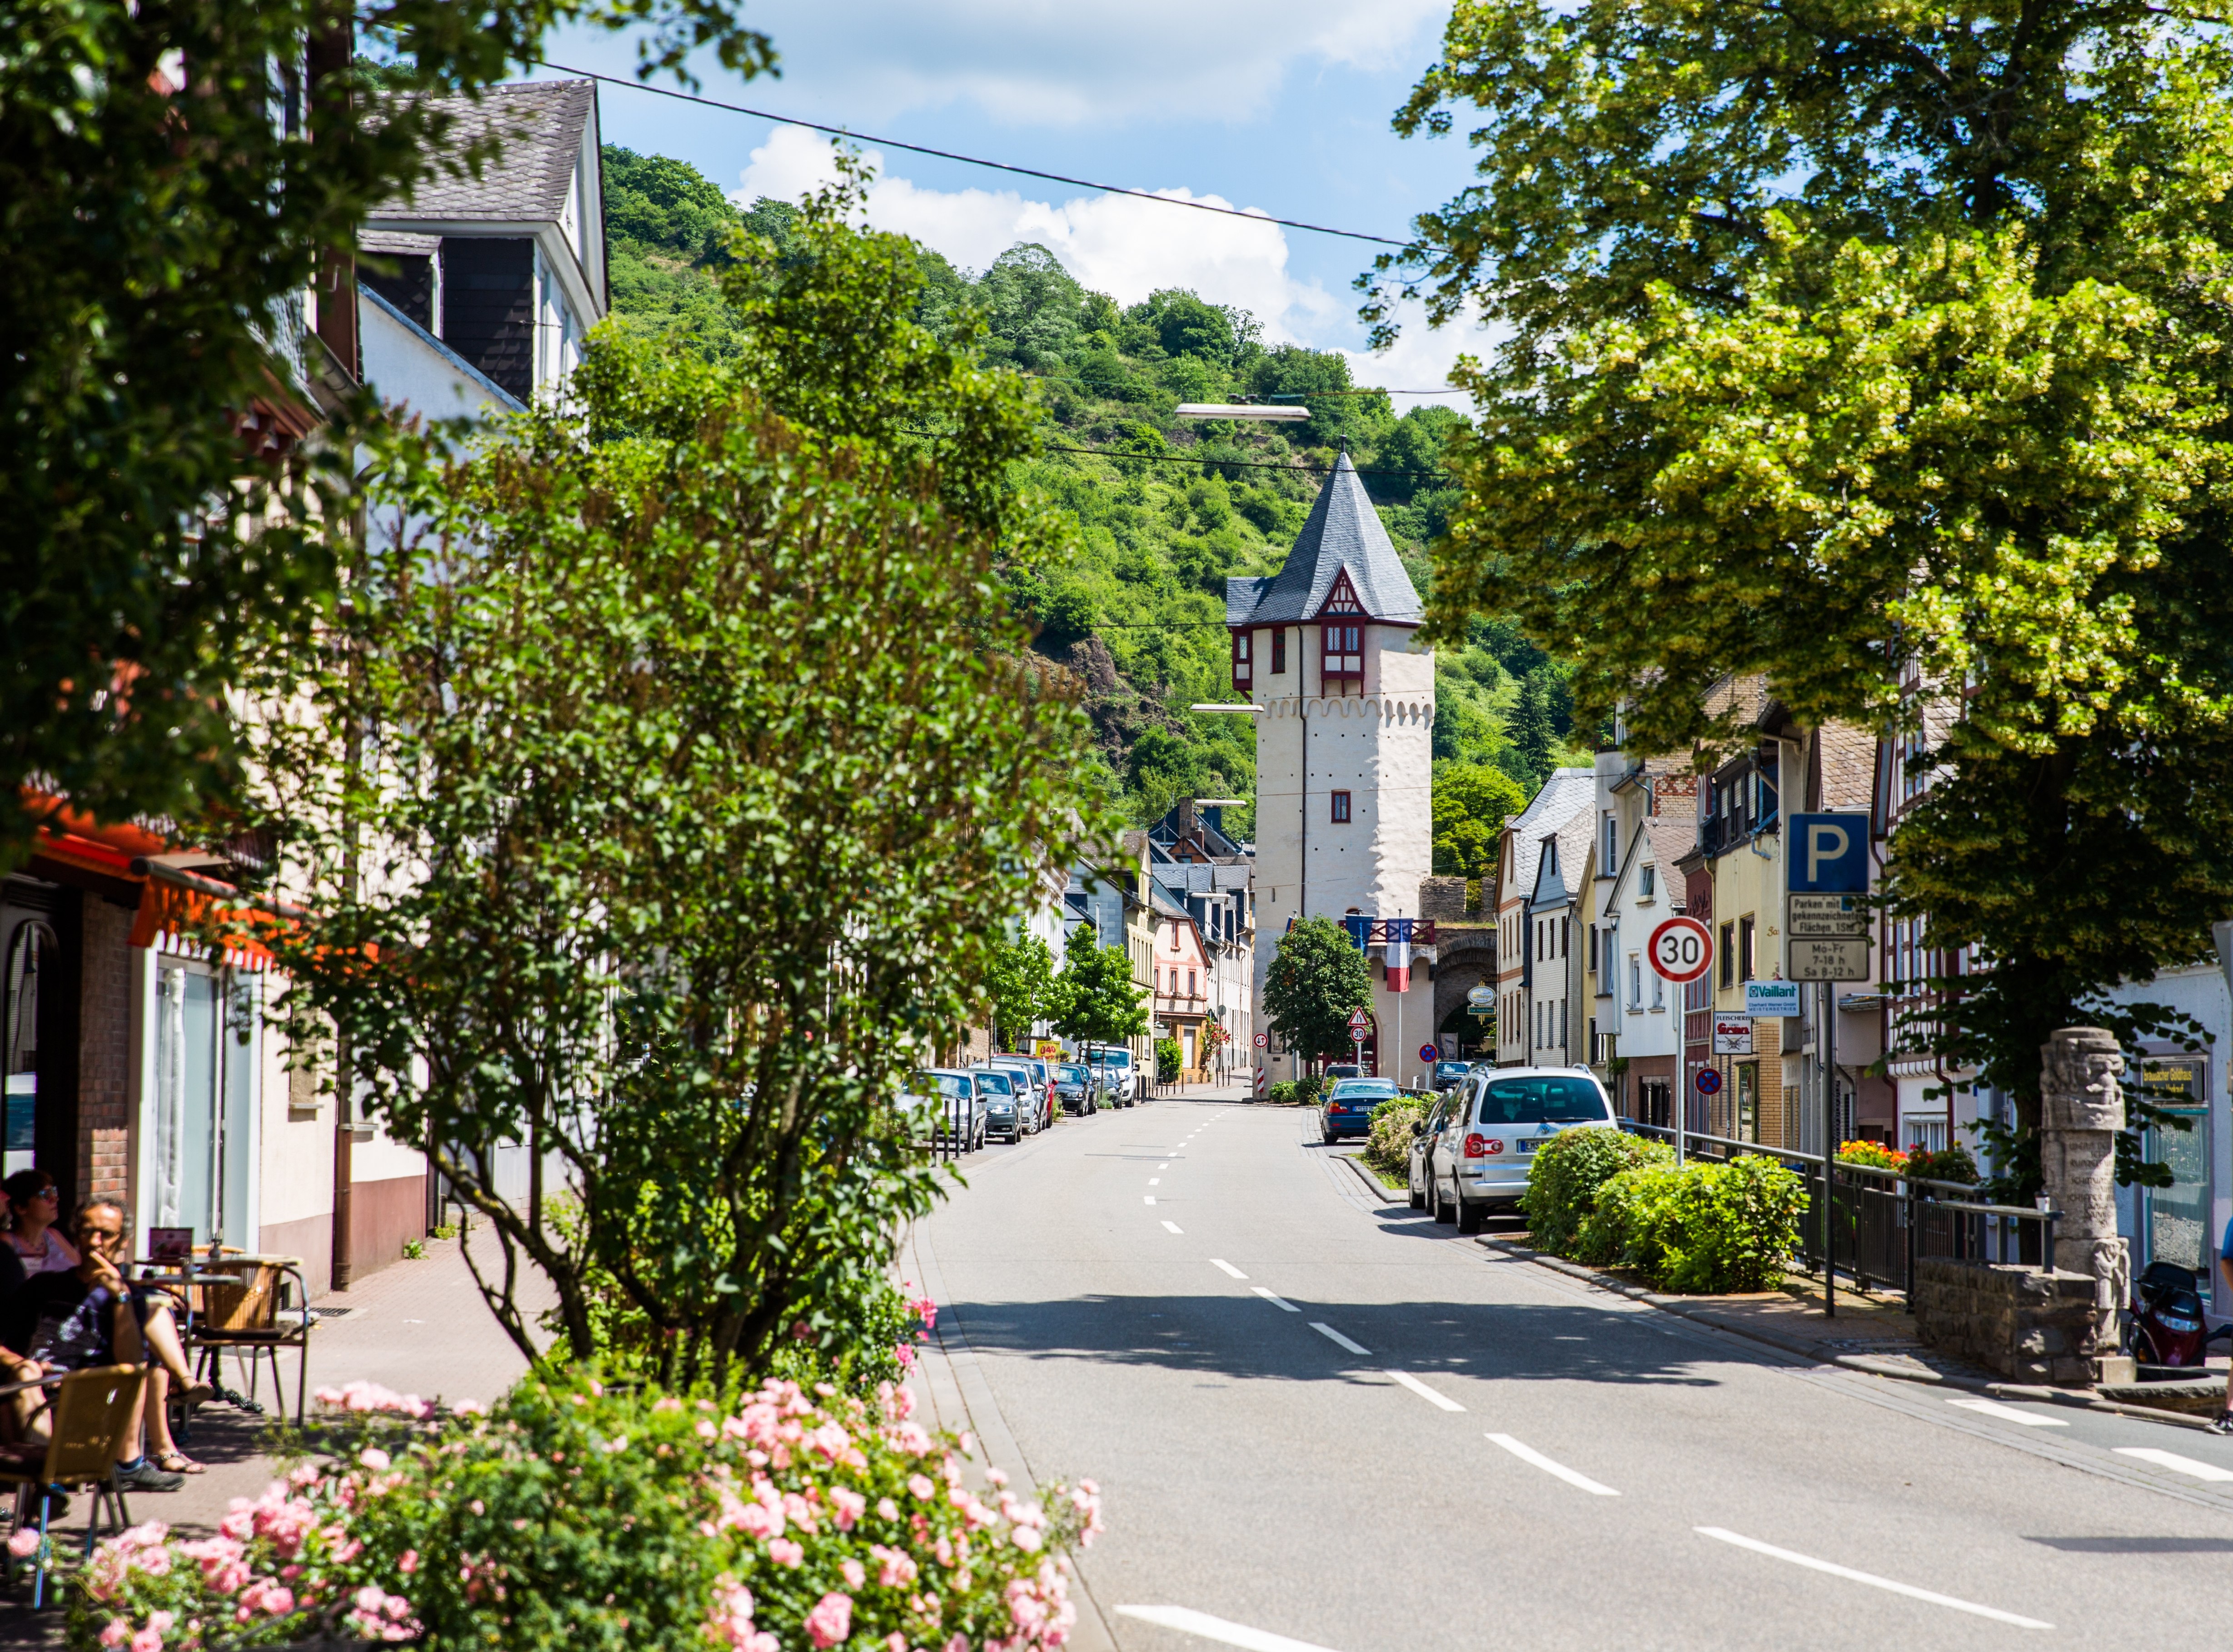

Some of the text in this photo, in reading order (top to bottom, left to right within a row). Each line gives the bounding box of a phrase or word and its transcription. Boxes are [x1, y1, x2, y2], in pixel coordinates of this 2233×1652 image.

[1808, 824, 1849, 882] P
[1794, 899, 1823, 909] Parken
[1826, 899, 1839, 908] mit
[1662, 936, 1698, 964] 30
[1812, 944, 1845, 953] Mo-Fr
[1813, 955, 1845, 965] 7-18 h
[1804, 967, 1854, 976] Sa 8-12 h
[1759, 985, 1796, 997] Vaillant
[2170, 1068, 2192, 1081] Goldhaus
